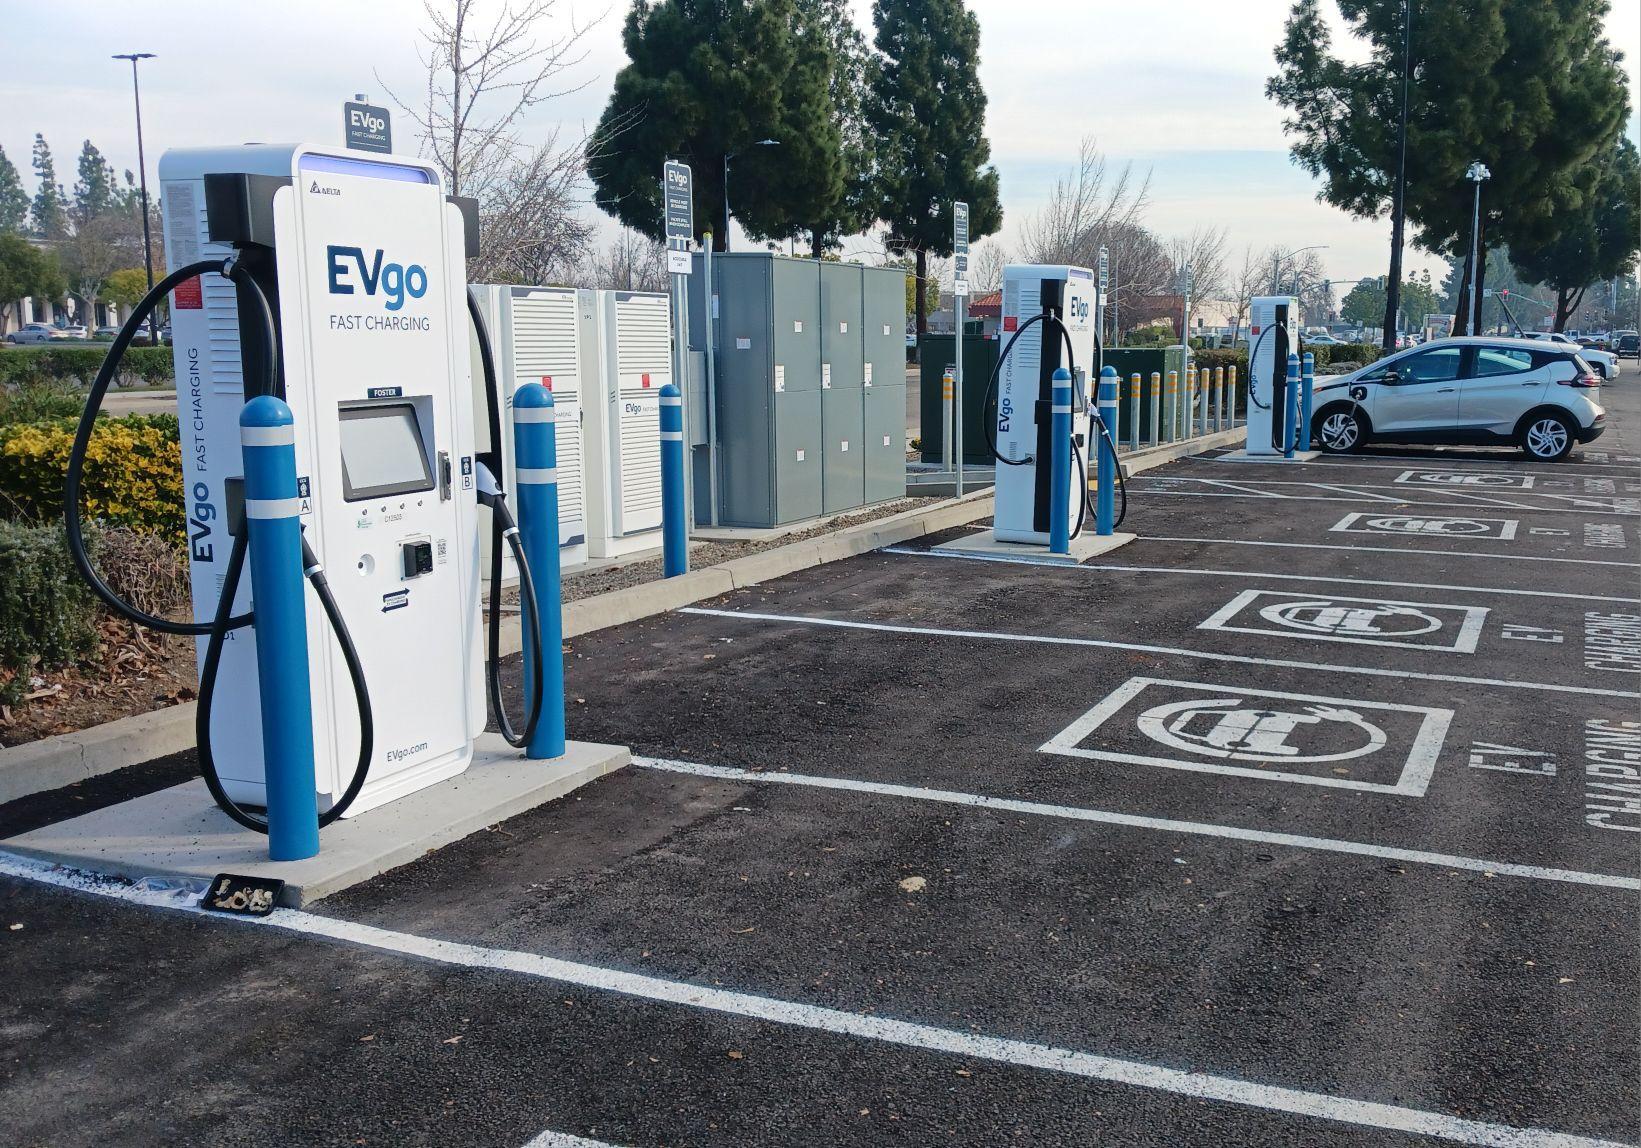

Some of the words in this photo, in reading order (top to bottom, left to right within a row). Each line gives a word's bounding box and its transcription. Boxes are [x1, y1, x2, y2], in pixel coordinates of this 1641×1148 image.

[350, 110, 385, 133] EVgo
[668, 170, 688, 186] EVgo
[326, 244, 428, 311] EVgo
[1071, 296, 1088, 323] EVgo
[330, 315, 362, 330] FAST
[366, 316, 430, 332] CHARGING
[188, 348, 204, 430] CHARGING
[374, 388, 396, 397] FOSTER
[625, 403, 642, 415] EVgo
[998, 398, 1014, 432] EVgo
[195, 434, 207, 472] FAST
[464, 476, 470, 487] B
[302, 500, 309, 512] A
[189, 482, 216, 562] EVgo
[1502, 624, 1564, 644] EV
[386, 740, 428, 763] EVgo.com
[1468, 741, 1557, 776] EV
